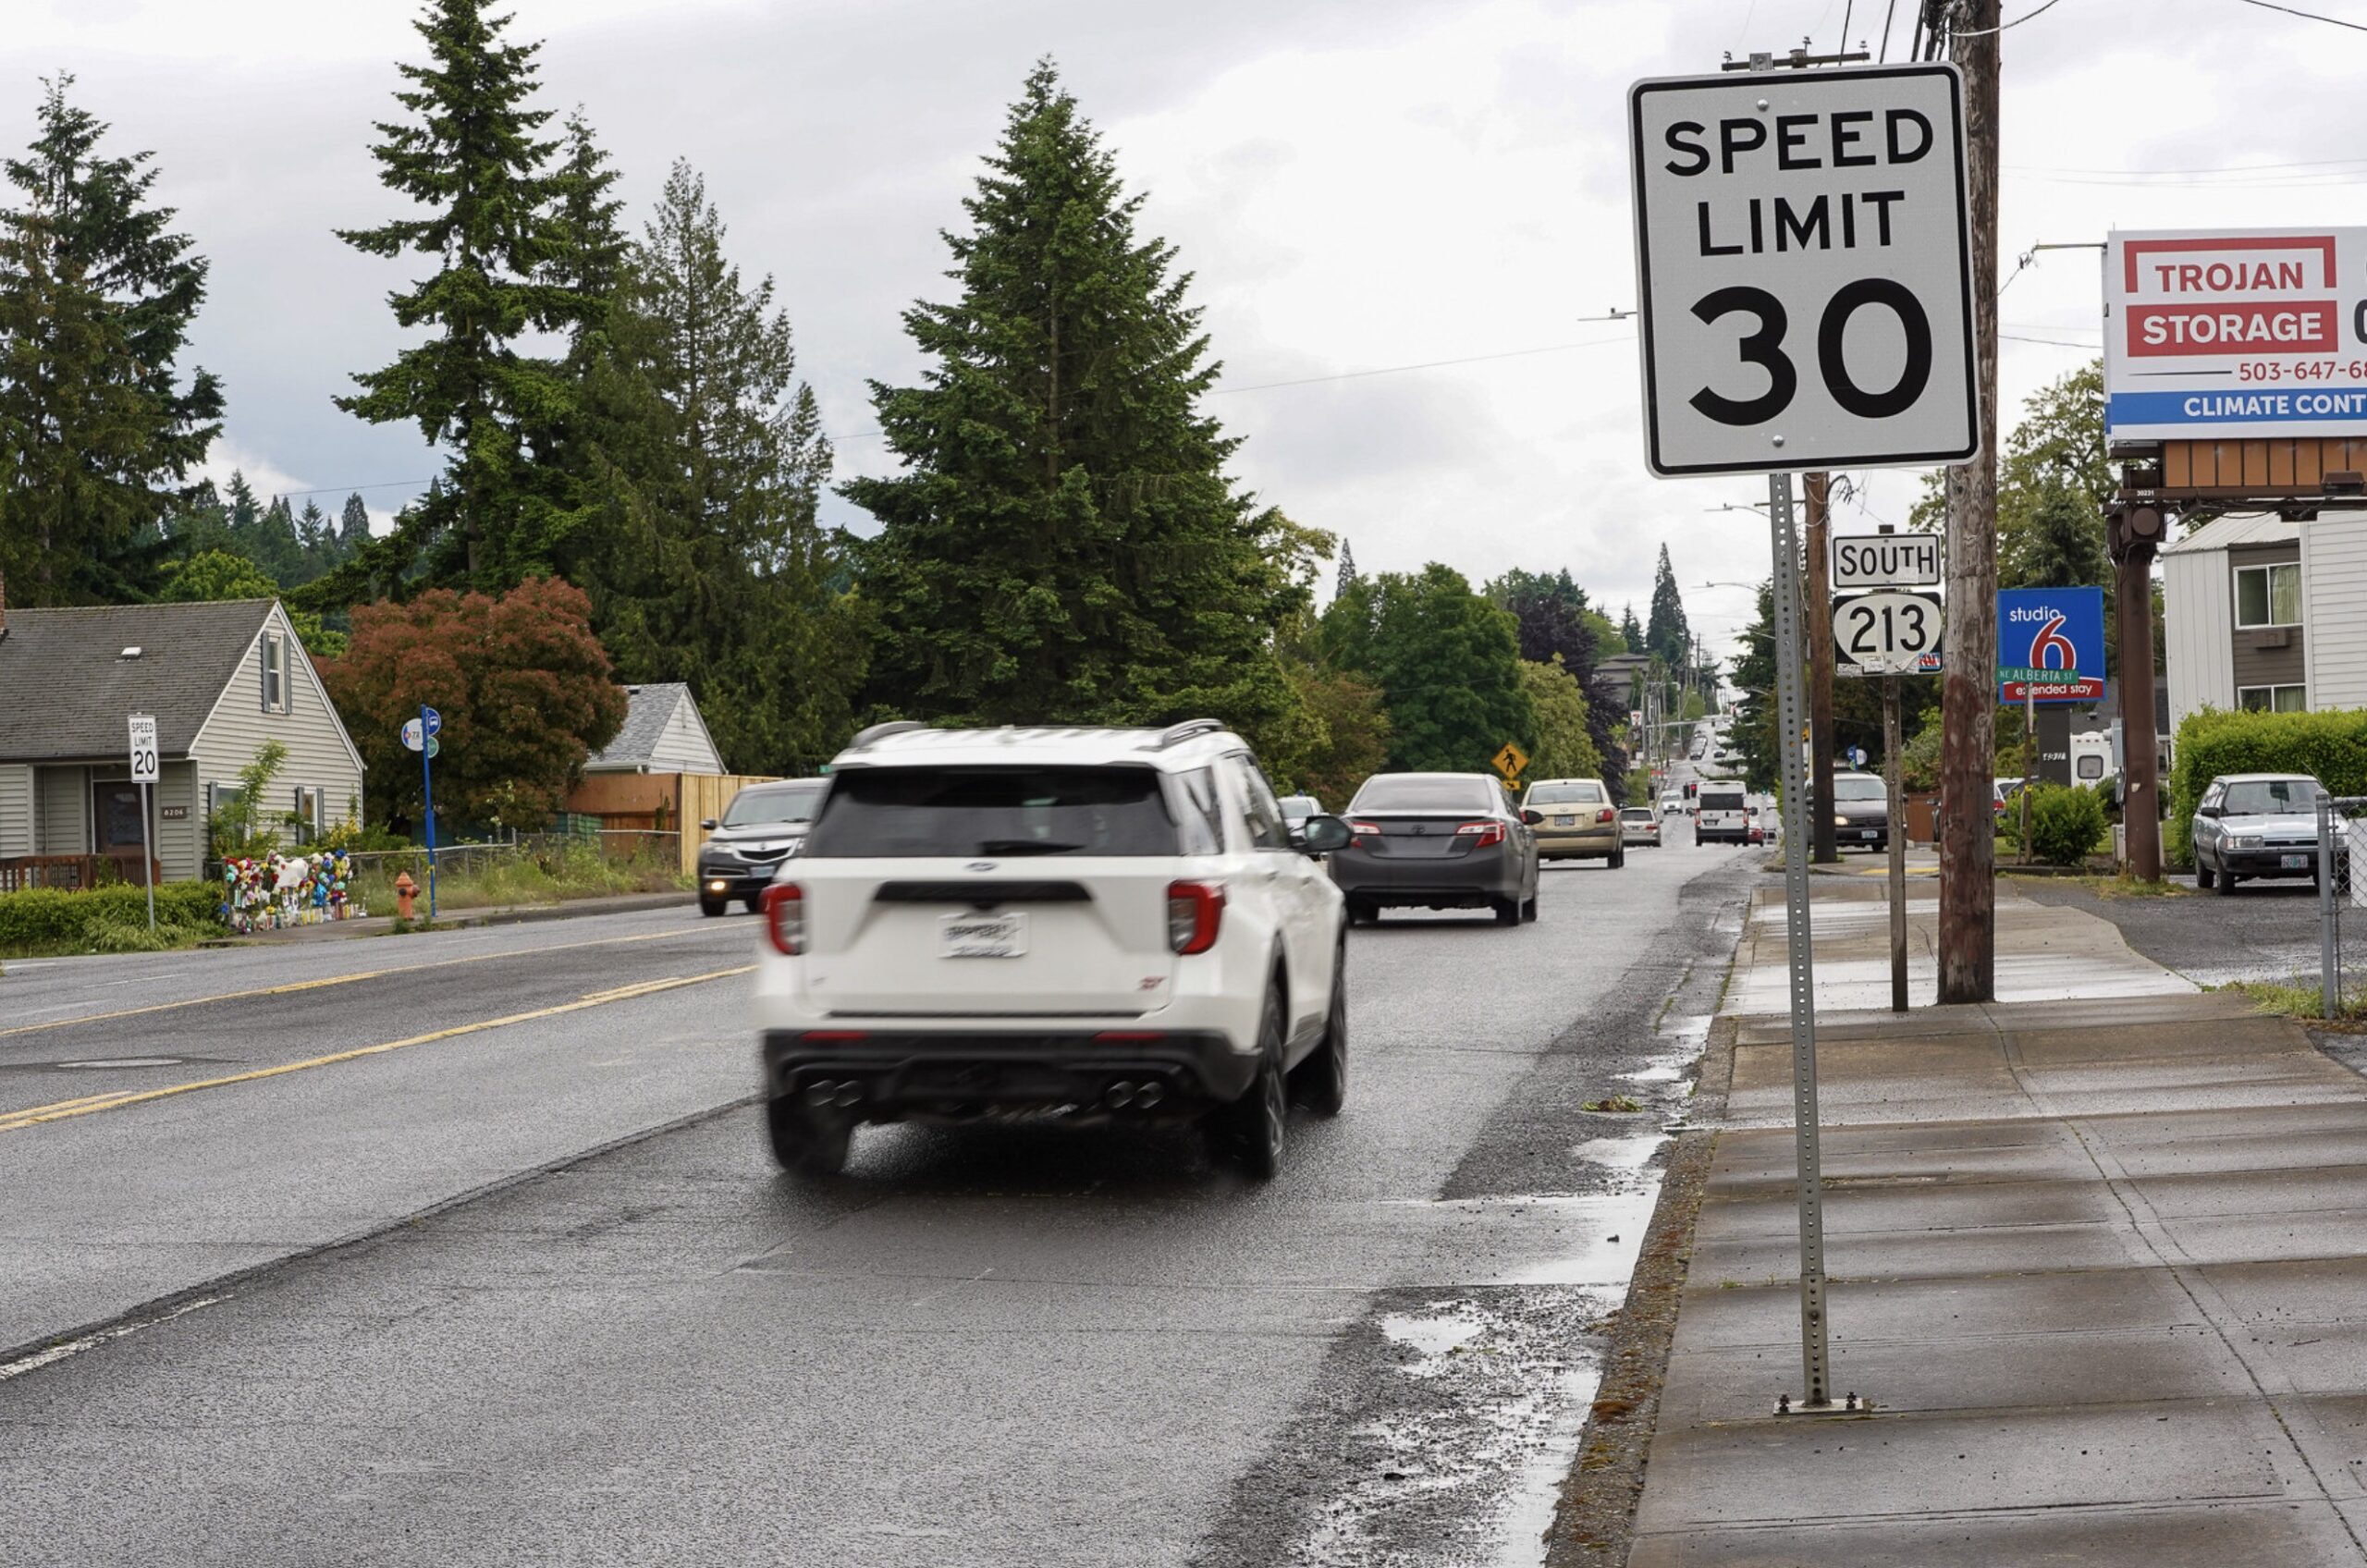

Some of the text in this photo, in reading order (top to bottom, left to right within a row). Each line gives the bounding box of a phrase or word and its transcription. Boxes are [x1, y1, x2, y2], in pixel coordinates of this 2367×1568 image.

[1664, 108, 1933, 177] SPEED
[1698, 190, 1905, 256] LIMIT
[2155, 262, 2303, 292] TROJAN
[2142, 312, 2323, 345] STORAGE
[1688, 277, 1932, 426] 30
[2239, 361, 2367, 381] 503-647-6
[2184, 393, 2367, 417] CLIMATE CONT
[1839, 545, 1933, 576] SOUTH
[2009, 606, 2061, 622] studio
[1849, 604, 1926, 654] 213
[2029, 615, 2077, 670] 6
[1999, 668, 2073, 681] NE ALBERTA ST
[2016, 683, 2092, 696] eended stay
[131, 722, 154, 733] SPEED
[134, 736, 153, 747] LIMIT
[133, 750, 155, 775] 20
